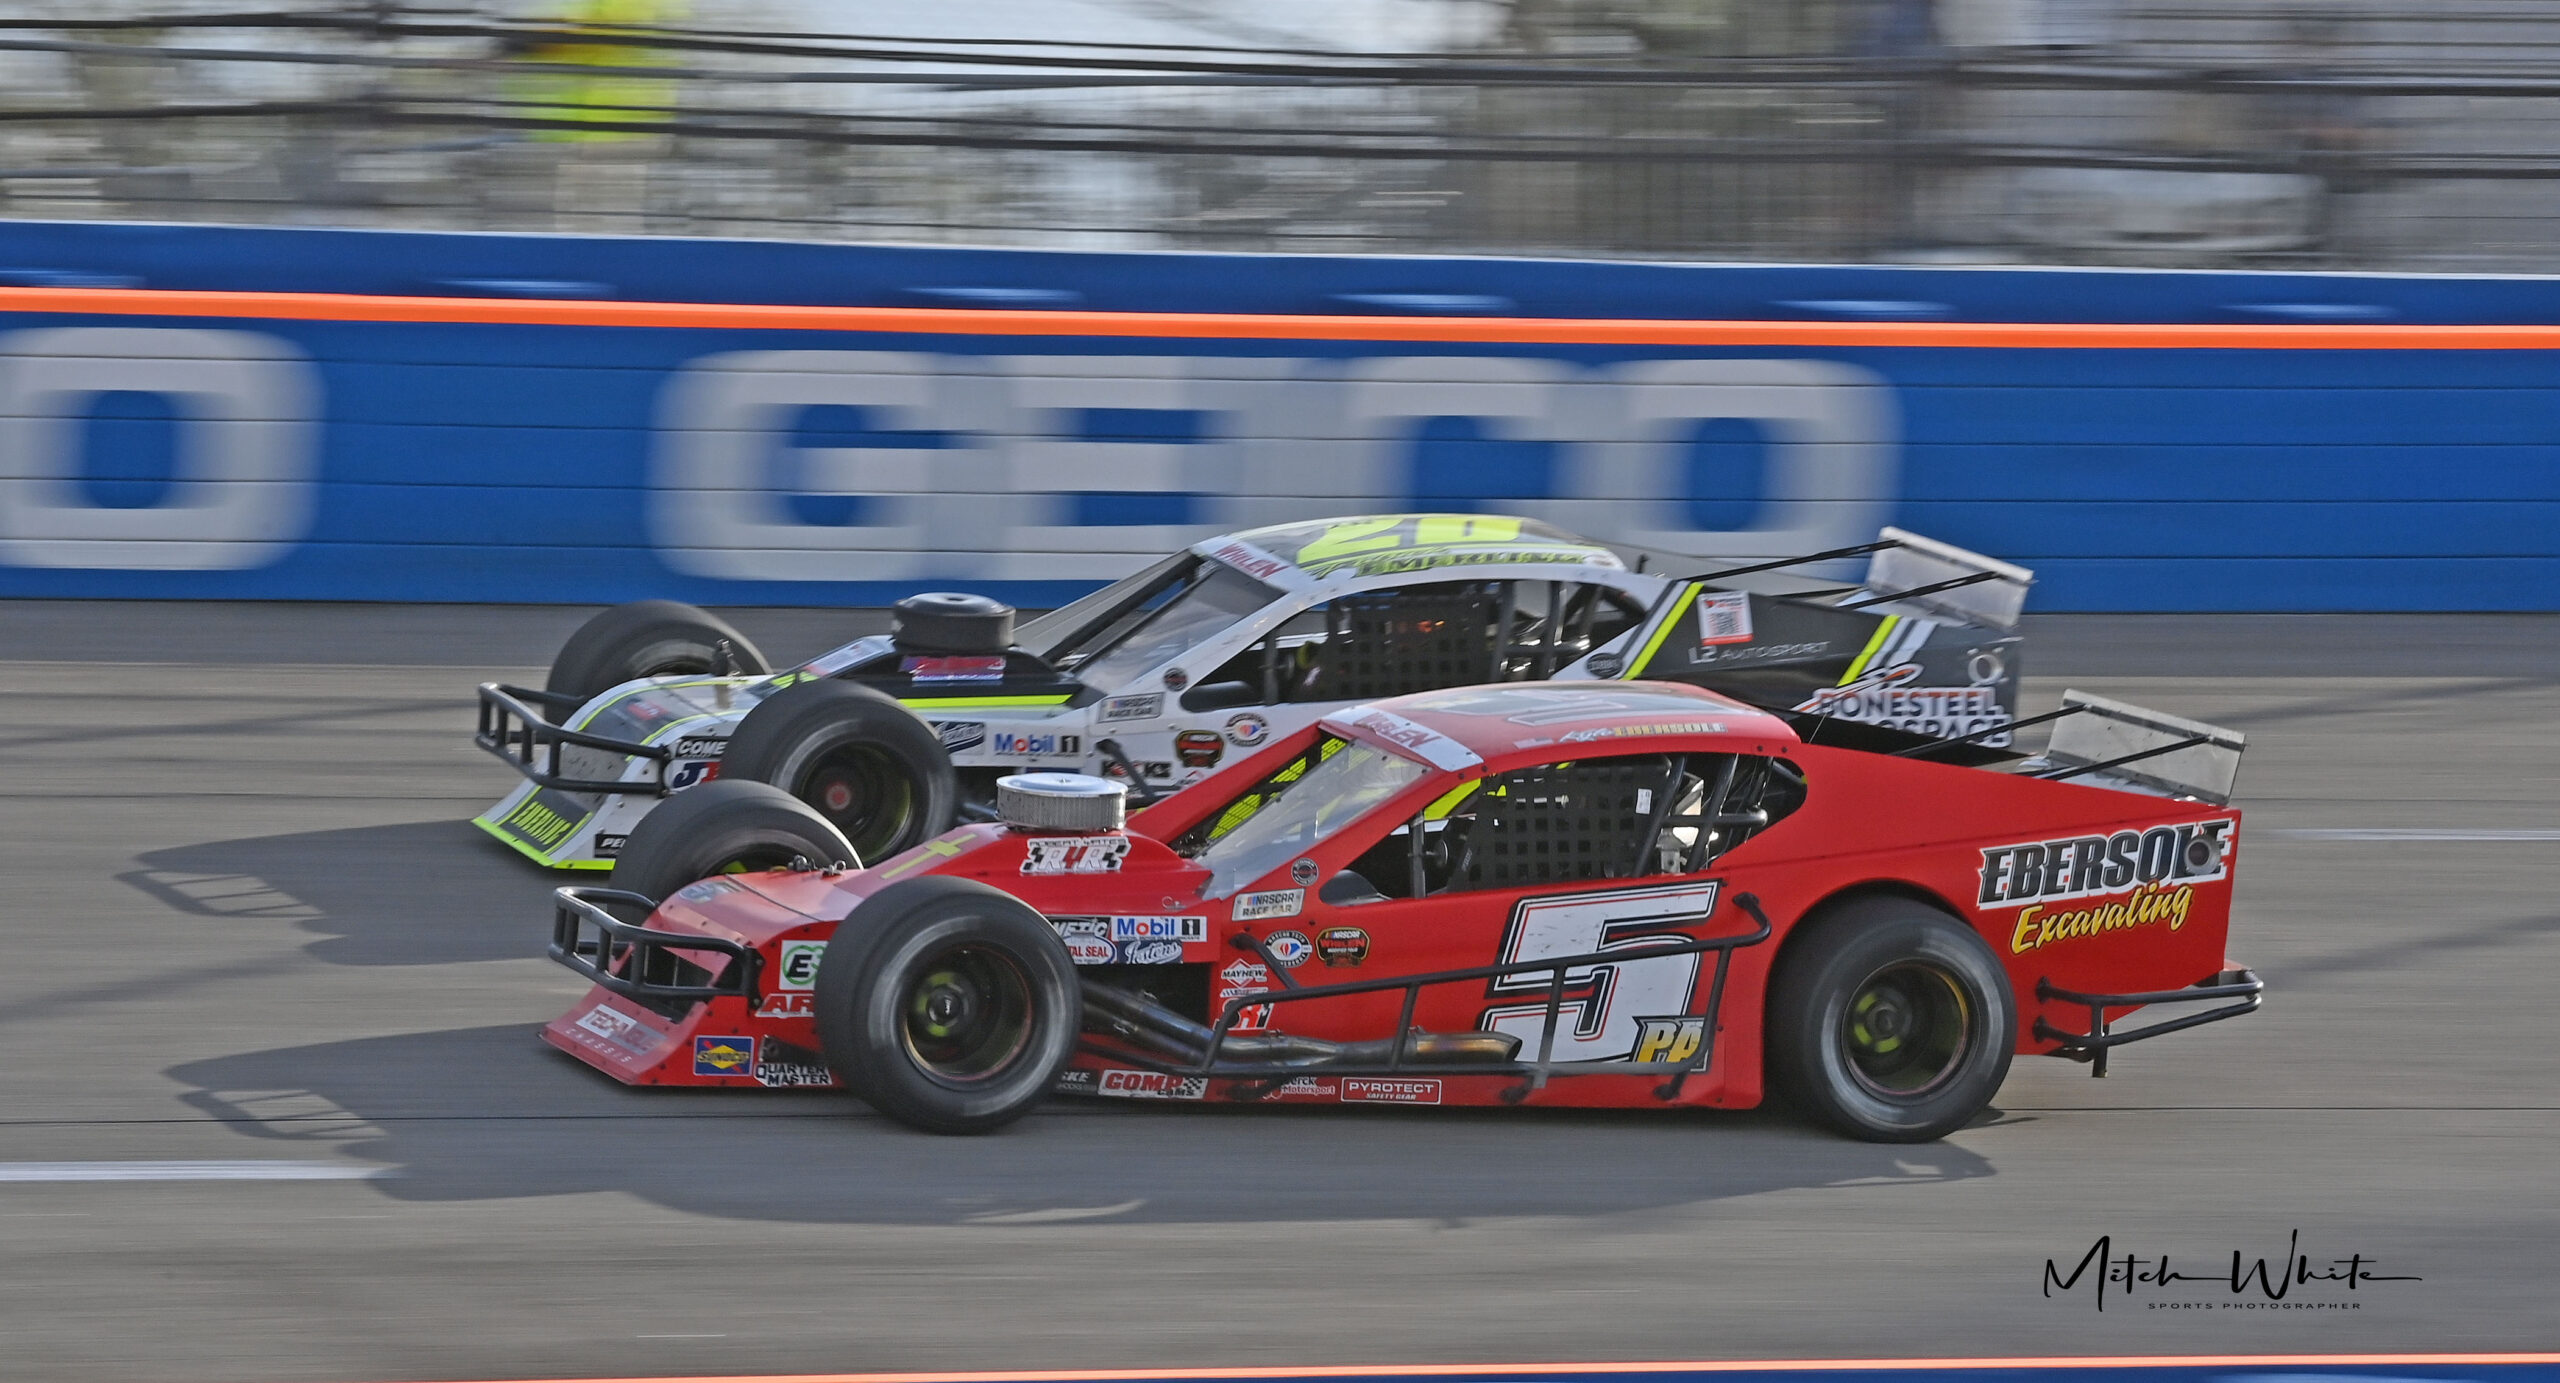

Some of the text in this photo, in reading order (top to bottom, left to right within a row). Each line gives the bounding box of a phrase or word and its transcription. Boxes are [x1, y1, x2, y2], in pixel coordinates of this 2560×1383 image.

[650, 350, 1905, 583] GEICO
[677, 741, 729, 755] COME
[995, 733, 1056, 754] Mobil
[1255, 892, 1295, 906] NASCAR
[1242, 903, 1293, 917] RACE CAR
[2010, 881, 2194, 955] Excavating
[1117, 918, 1174, 936] Mobil
[1085, 946, 1110, 957] SEAL
[1478, 880, 1722, 1065] 5
[755, 1063, 827, 1078] QUARTER
[768, 1074, 829, 1086] MASTER
[1105, 1072, 1184, 1092] COMP
[1157, 1088, 1195, 1097] CAMS
[1349, 1081, 1434, 1095] PYROTECT
[1365, 1092, 1417, 1101] SAFETY GEAR
